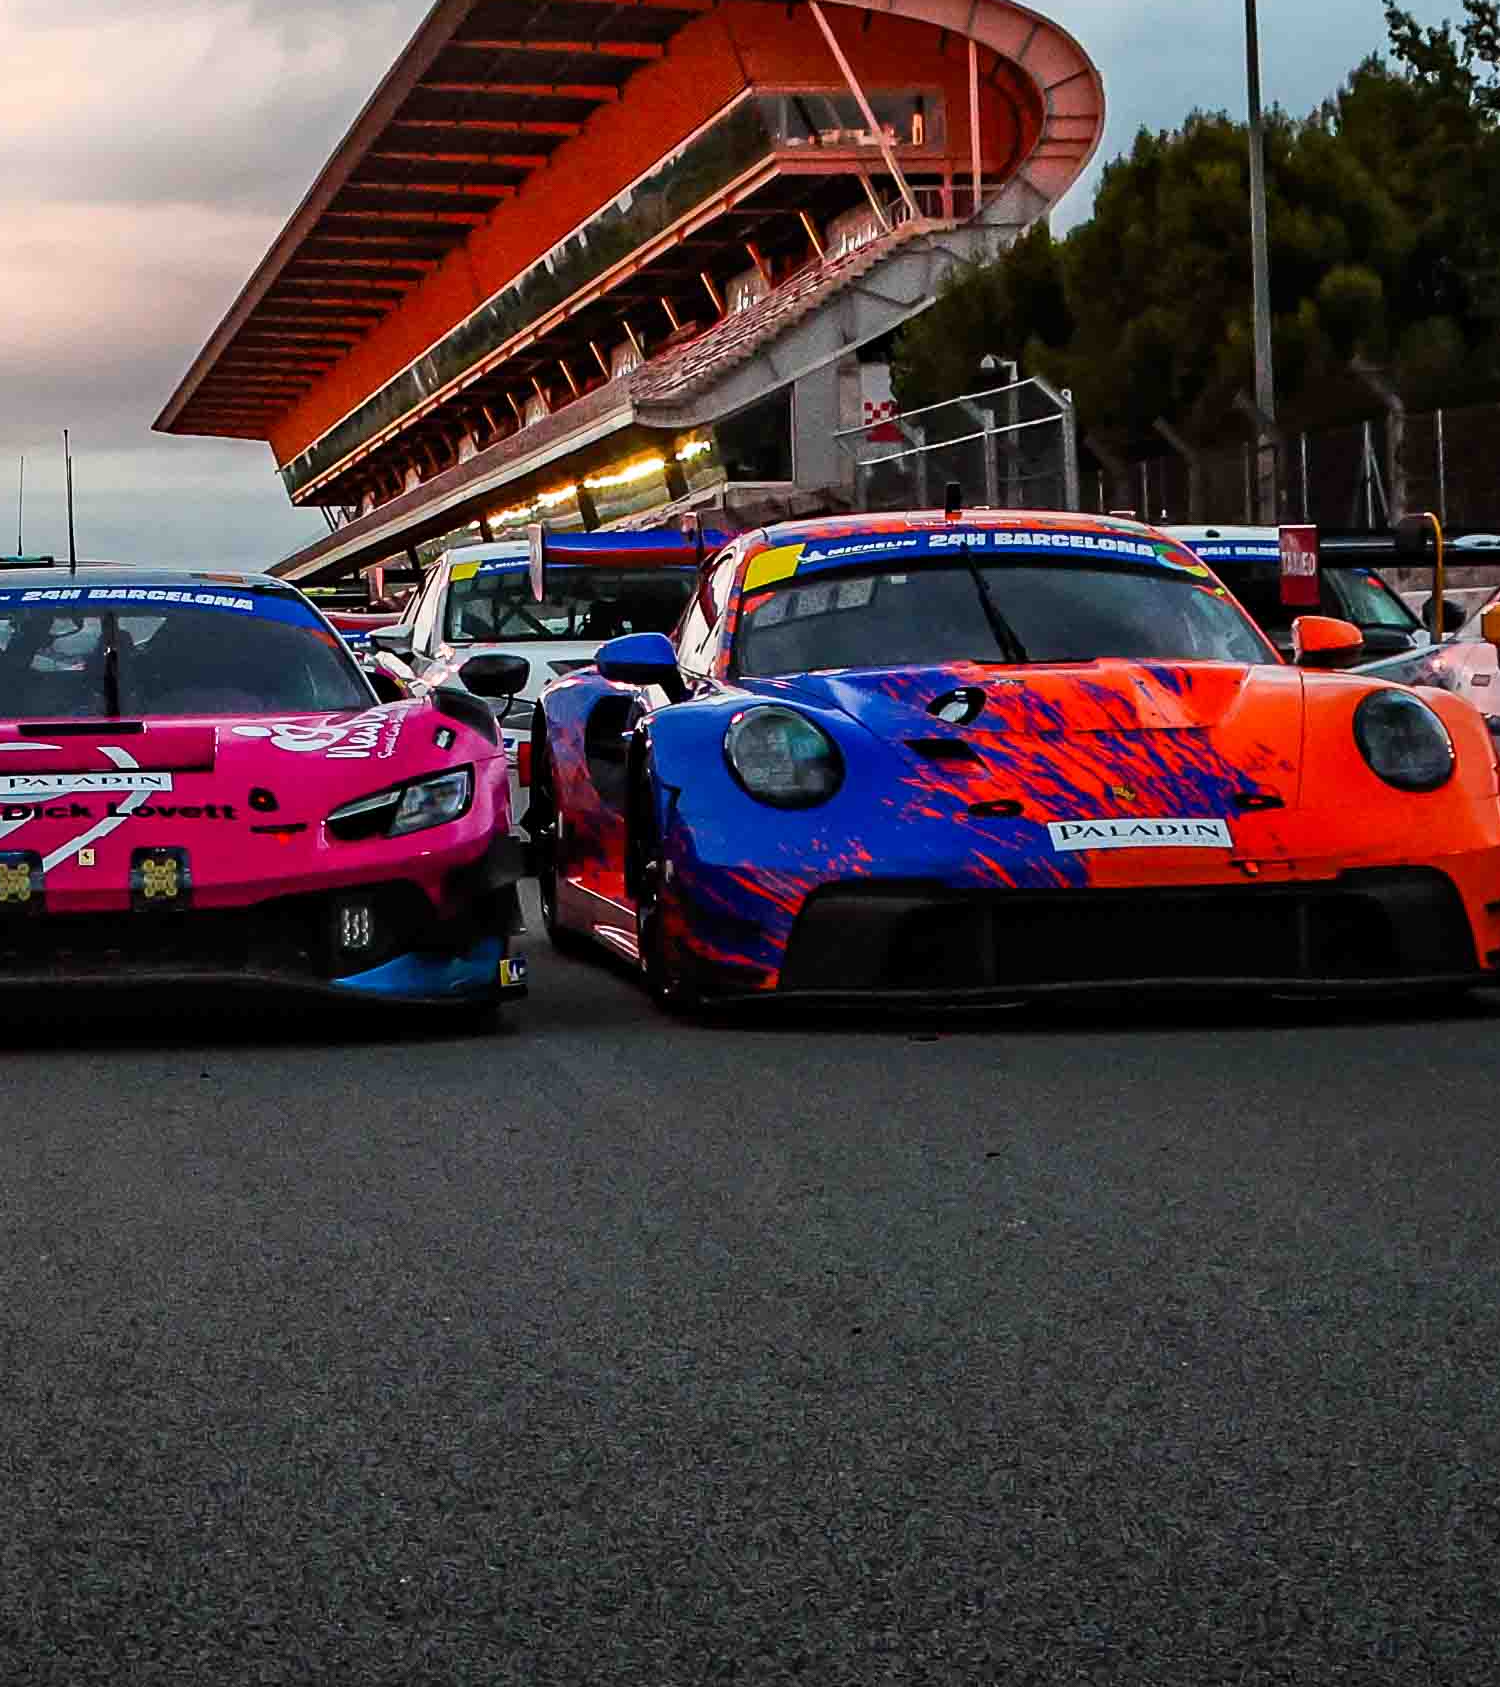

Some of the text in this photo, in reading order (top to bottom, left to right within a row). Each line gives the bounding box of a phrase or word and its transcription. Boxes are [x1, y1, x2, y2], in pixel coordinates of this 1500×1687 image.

[827, 532, 1157, 558] MICHELIN 24H BARCELONA
[21, 589, 81, 602] 24H
[86, 589, 254, 610] BARCELONA
[8, 776, 164, 788] PALADIN
[2, 802, 238, 821] Dick Lovett
[1058, 823, 1221, 841] PALADIN
